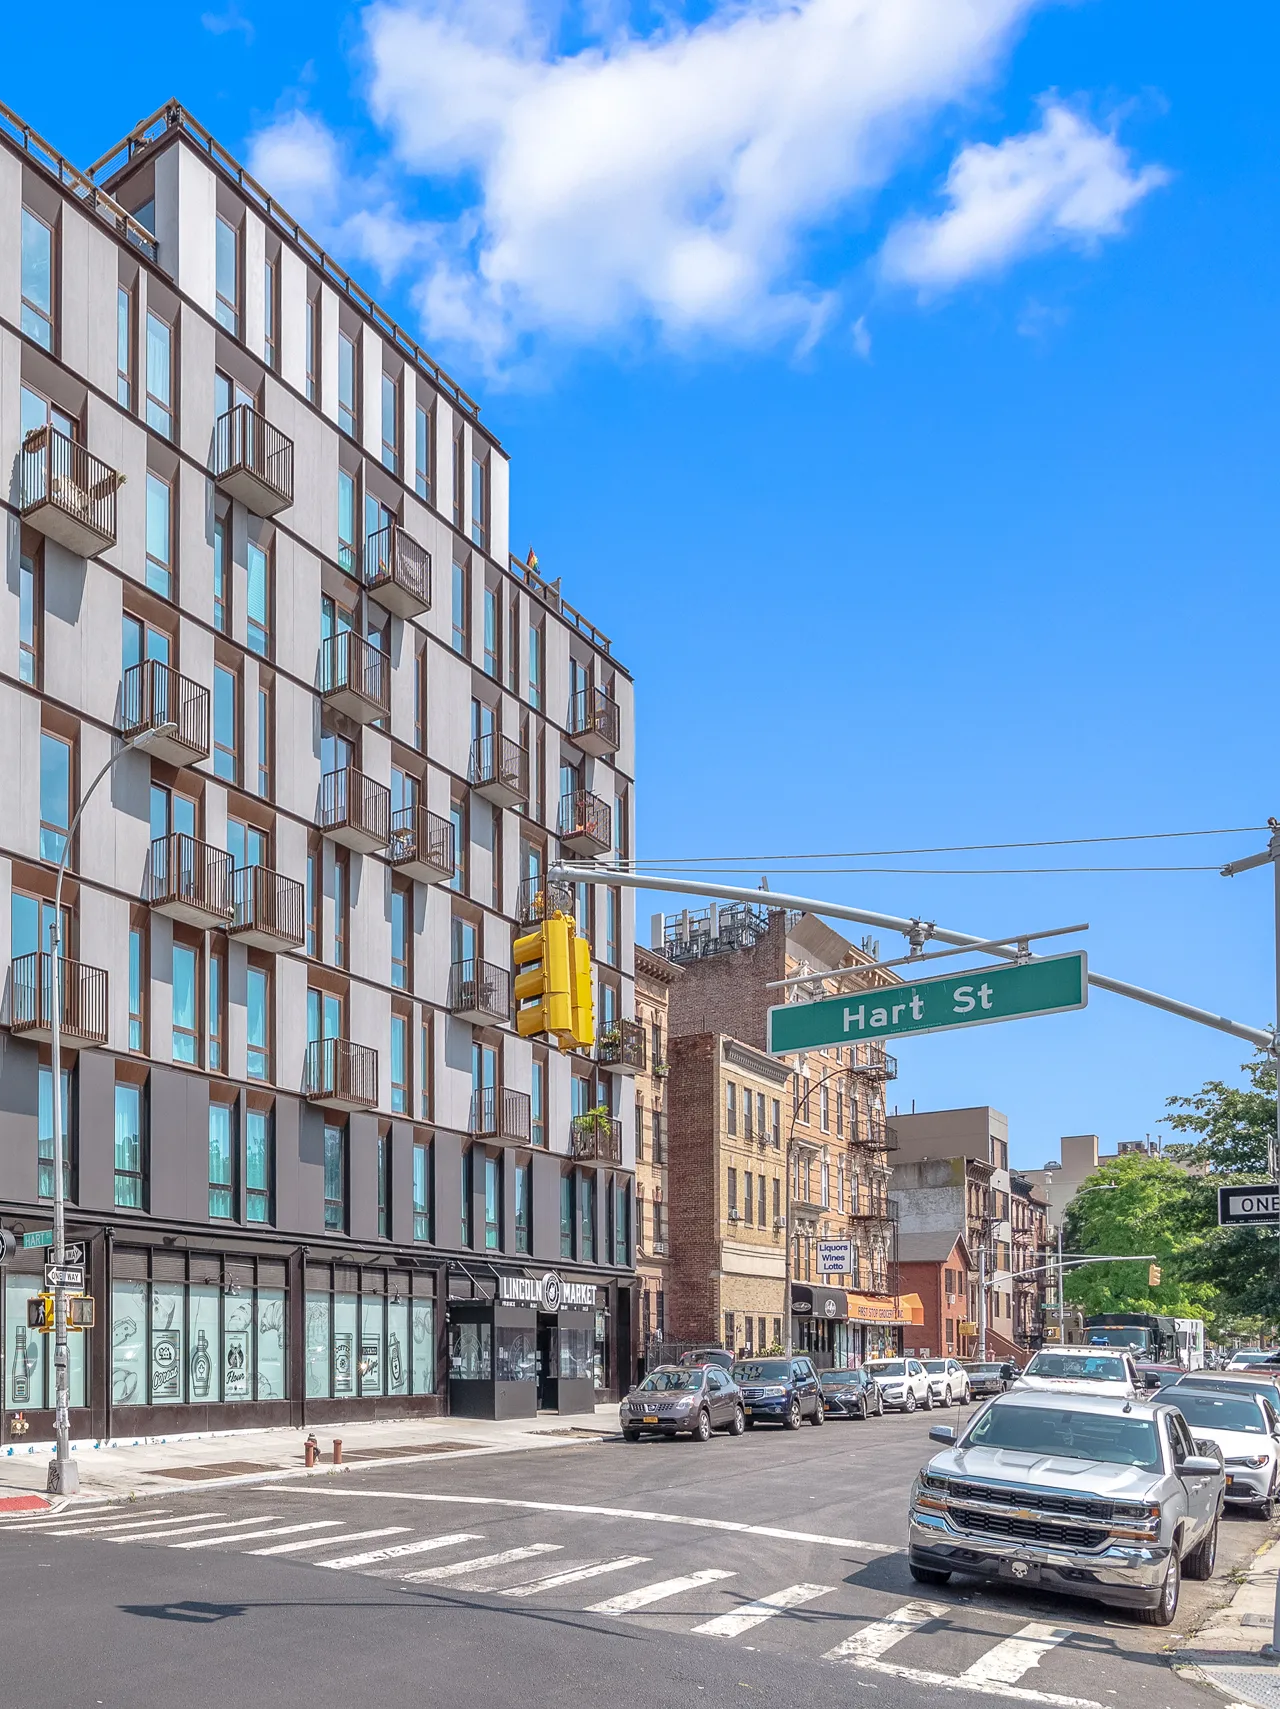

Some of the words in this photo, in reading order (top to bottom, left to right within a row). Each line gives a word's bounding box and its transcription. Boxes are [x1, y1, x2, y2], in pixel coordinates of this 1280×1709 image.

[843, 990, 924, 1032] Hart
[953, 982, 993, 1013] St
[1241, 1197, 1279, 1213] ONE
[25, 1233, 45, 1247] HART
[67, 1249, 78, 1259] WAY
[819, 1244, 848, 1252] Liquors
[51, 1272, 63, 1281] ONE
[67, 1273, 78, 1281] WAY
[503, 1277, 542, 1301] LINCOLN
[563, 1283, 597, 1305] MARKET
[858, 1306, 868, 1317] FIRST
[869, 1307, 878, 1318] STOP
[226, 1370, 245, 1385] Flour
